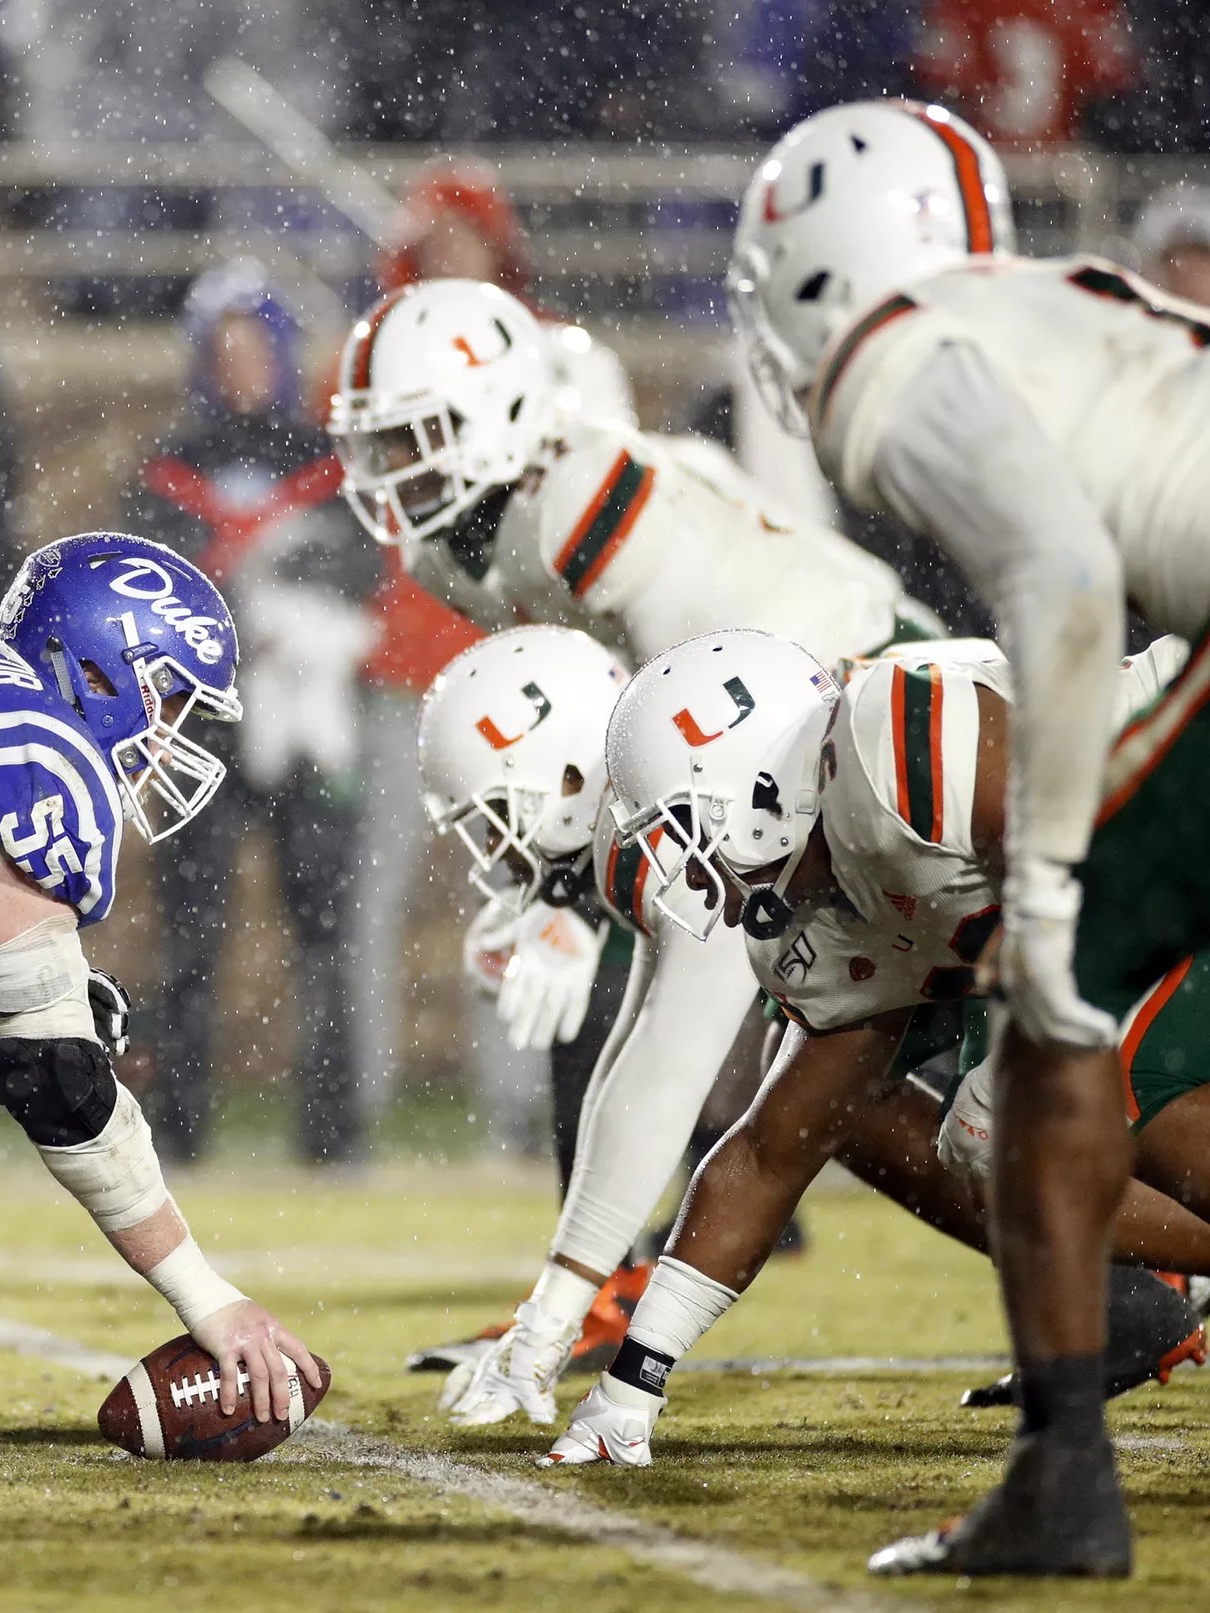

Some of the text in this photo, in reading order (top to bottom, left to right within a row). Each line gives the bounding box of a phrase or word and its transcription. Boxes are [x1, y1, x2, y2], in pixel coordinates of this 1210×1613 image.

[761, 161, 824, 223] U
[452, 317, 513, 368] U
[109, 557, 224, 665] Duke
[475, 681, 552, 750] U
[672, 676, 756, 748] U
[0, 793, 83, 889] 55
